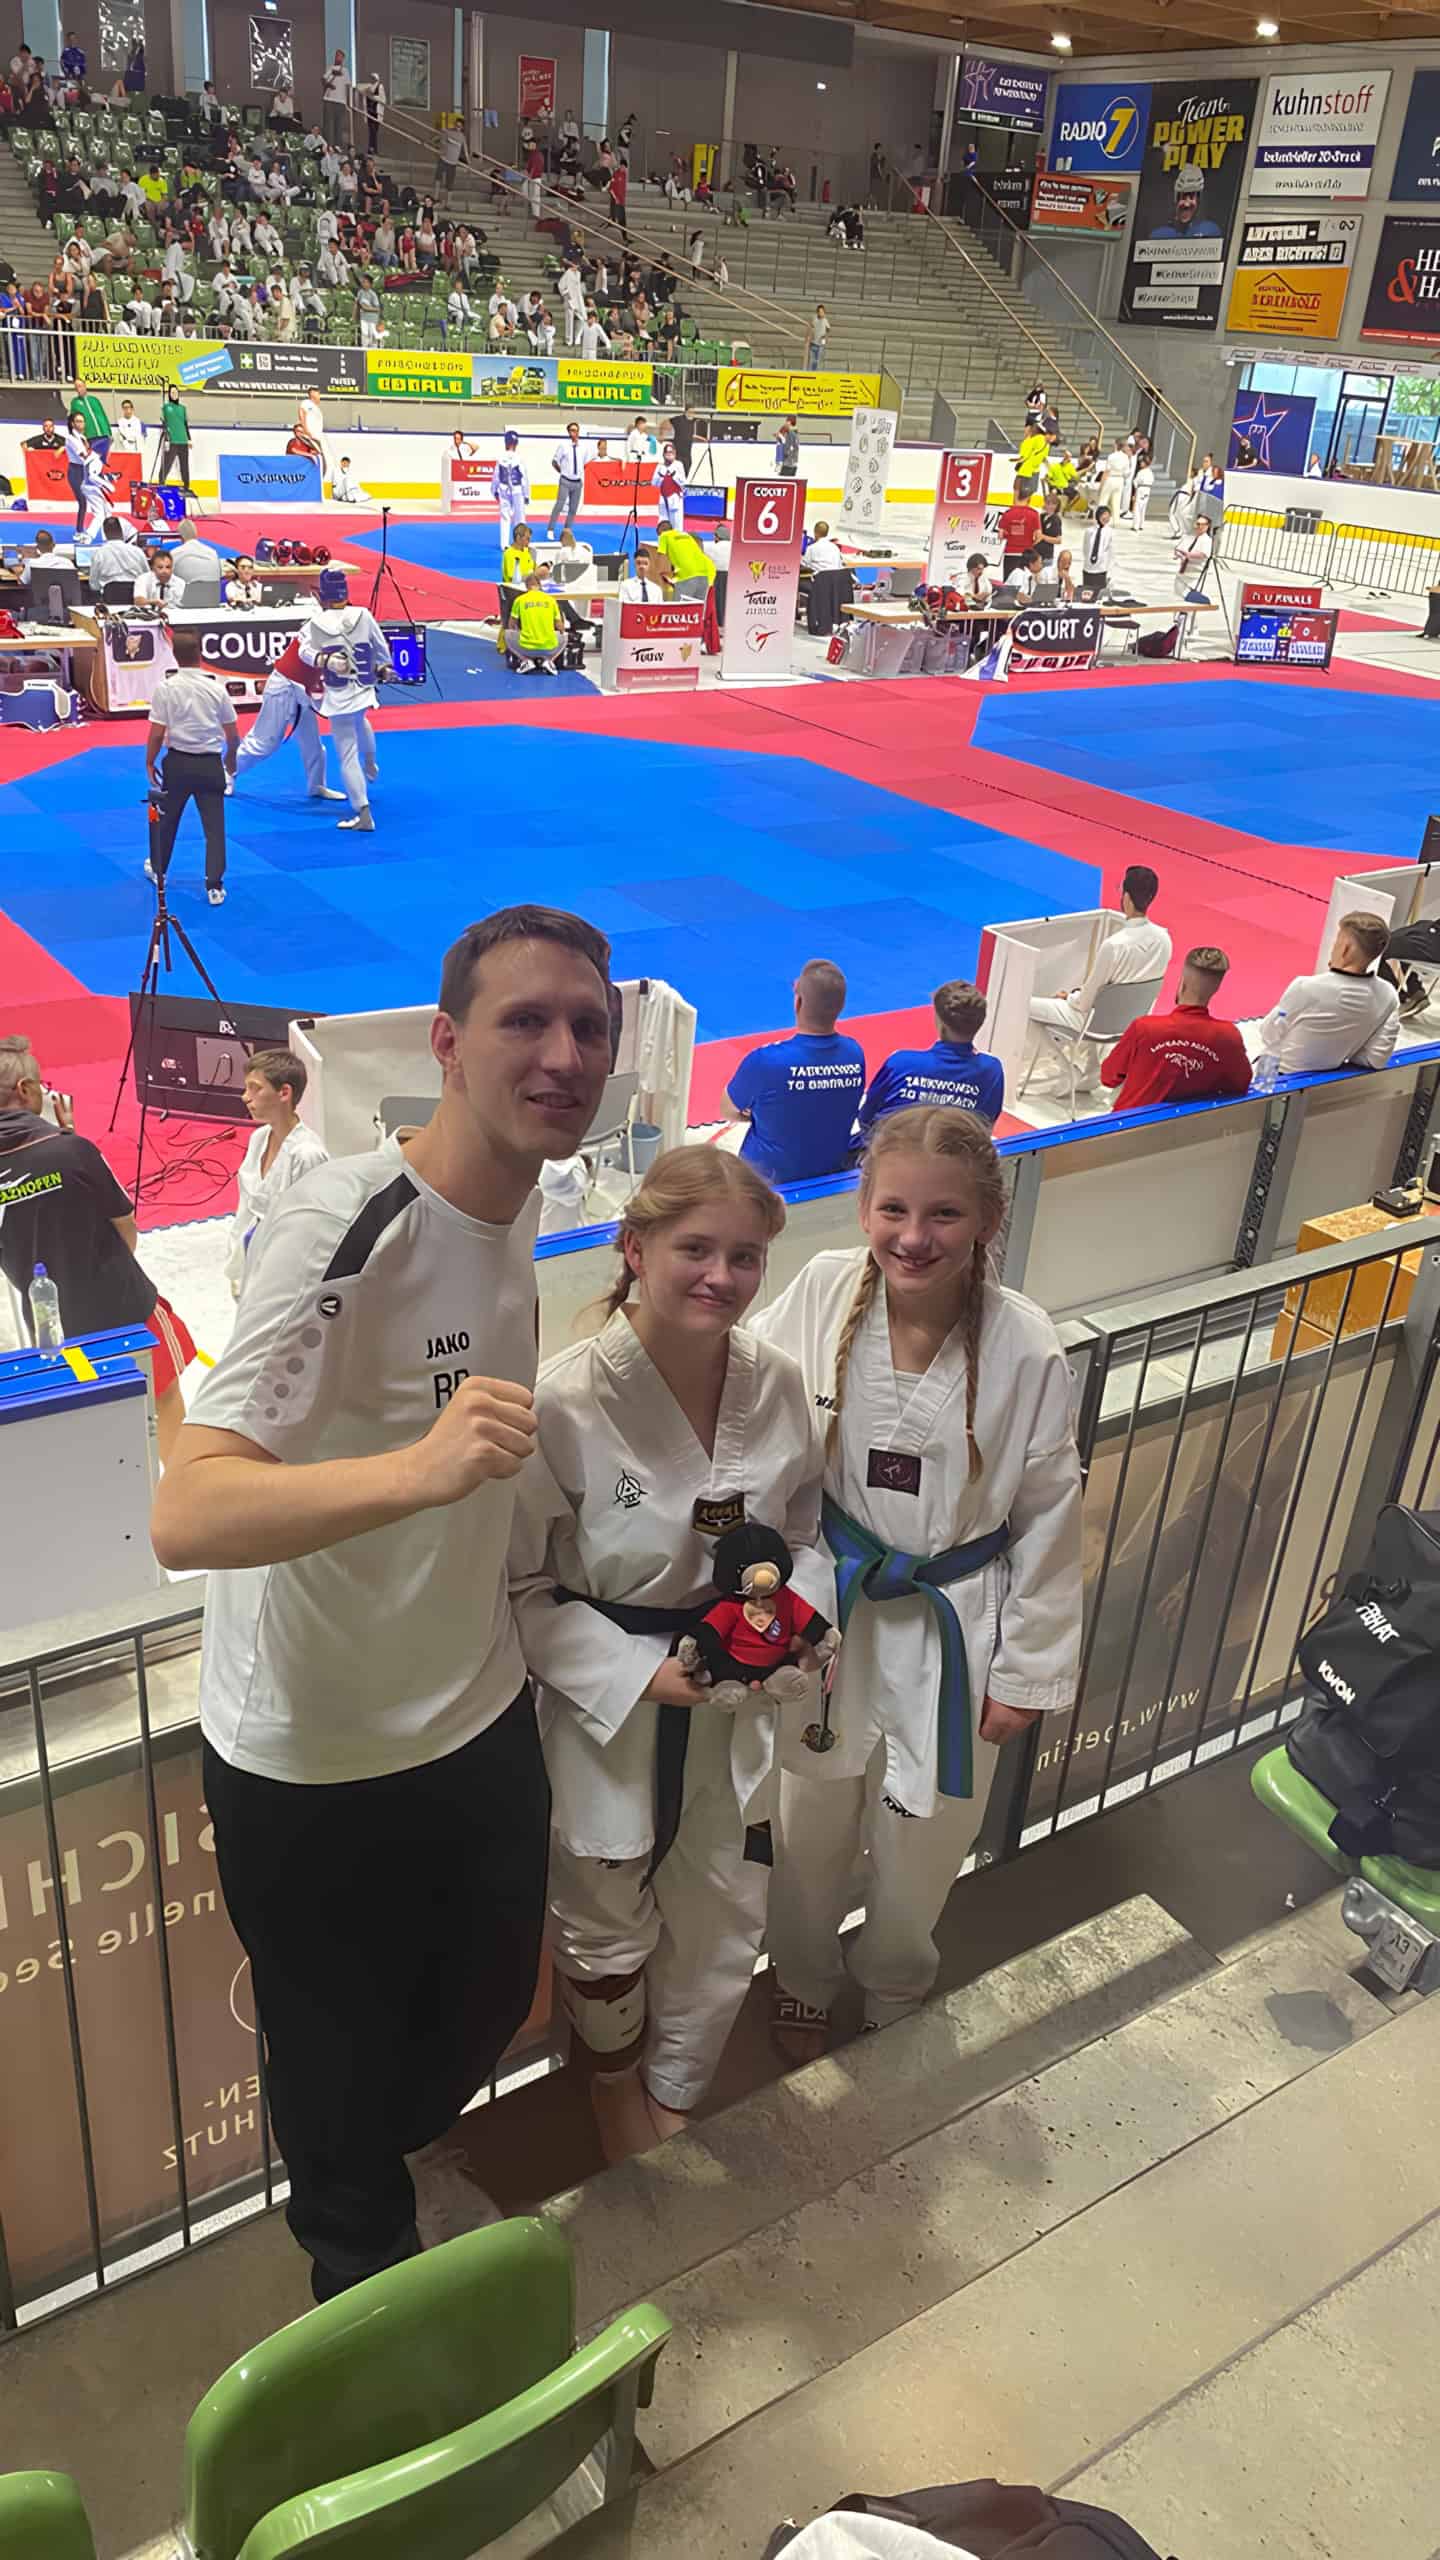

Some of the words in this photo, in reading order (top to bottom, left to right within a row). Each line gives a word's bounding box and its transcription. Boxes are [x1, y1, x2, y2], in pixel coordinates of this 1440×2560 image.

[1272, 84, 1375, 116] kuhnstoff
[1060, 121, 1107, 141] RADIO
[1105, 108, 1137, 153] 7
[1152, 115, 1244, 148] POWER
[1163, 142, 1227, 172] PLAY
[1387, 258, 1417, 304] &
[955, 469, 972, 497] 3
[757, 501, 779, 535] 6
[1015, 618, 1080, 642] COURT
[1083, 617, 1094, 639] 6
[790, 1064, 862, 1077] TAEKWONDO
[904, 1076, 980, 1096] TAEKWONDO
[426, 1331, 470, 1360] JAKO
[1318, 1659, 1356, 1705] KWON
[780, 2001, 827, 2020] FILA
